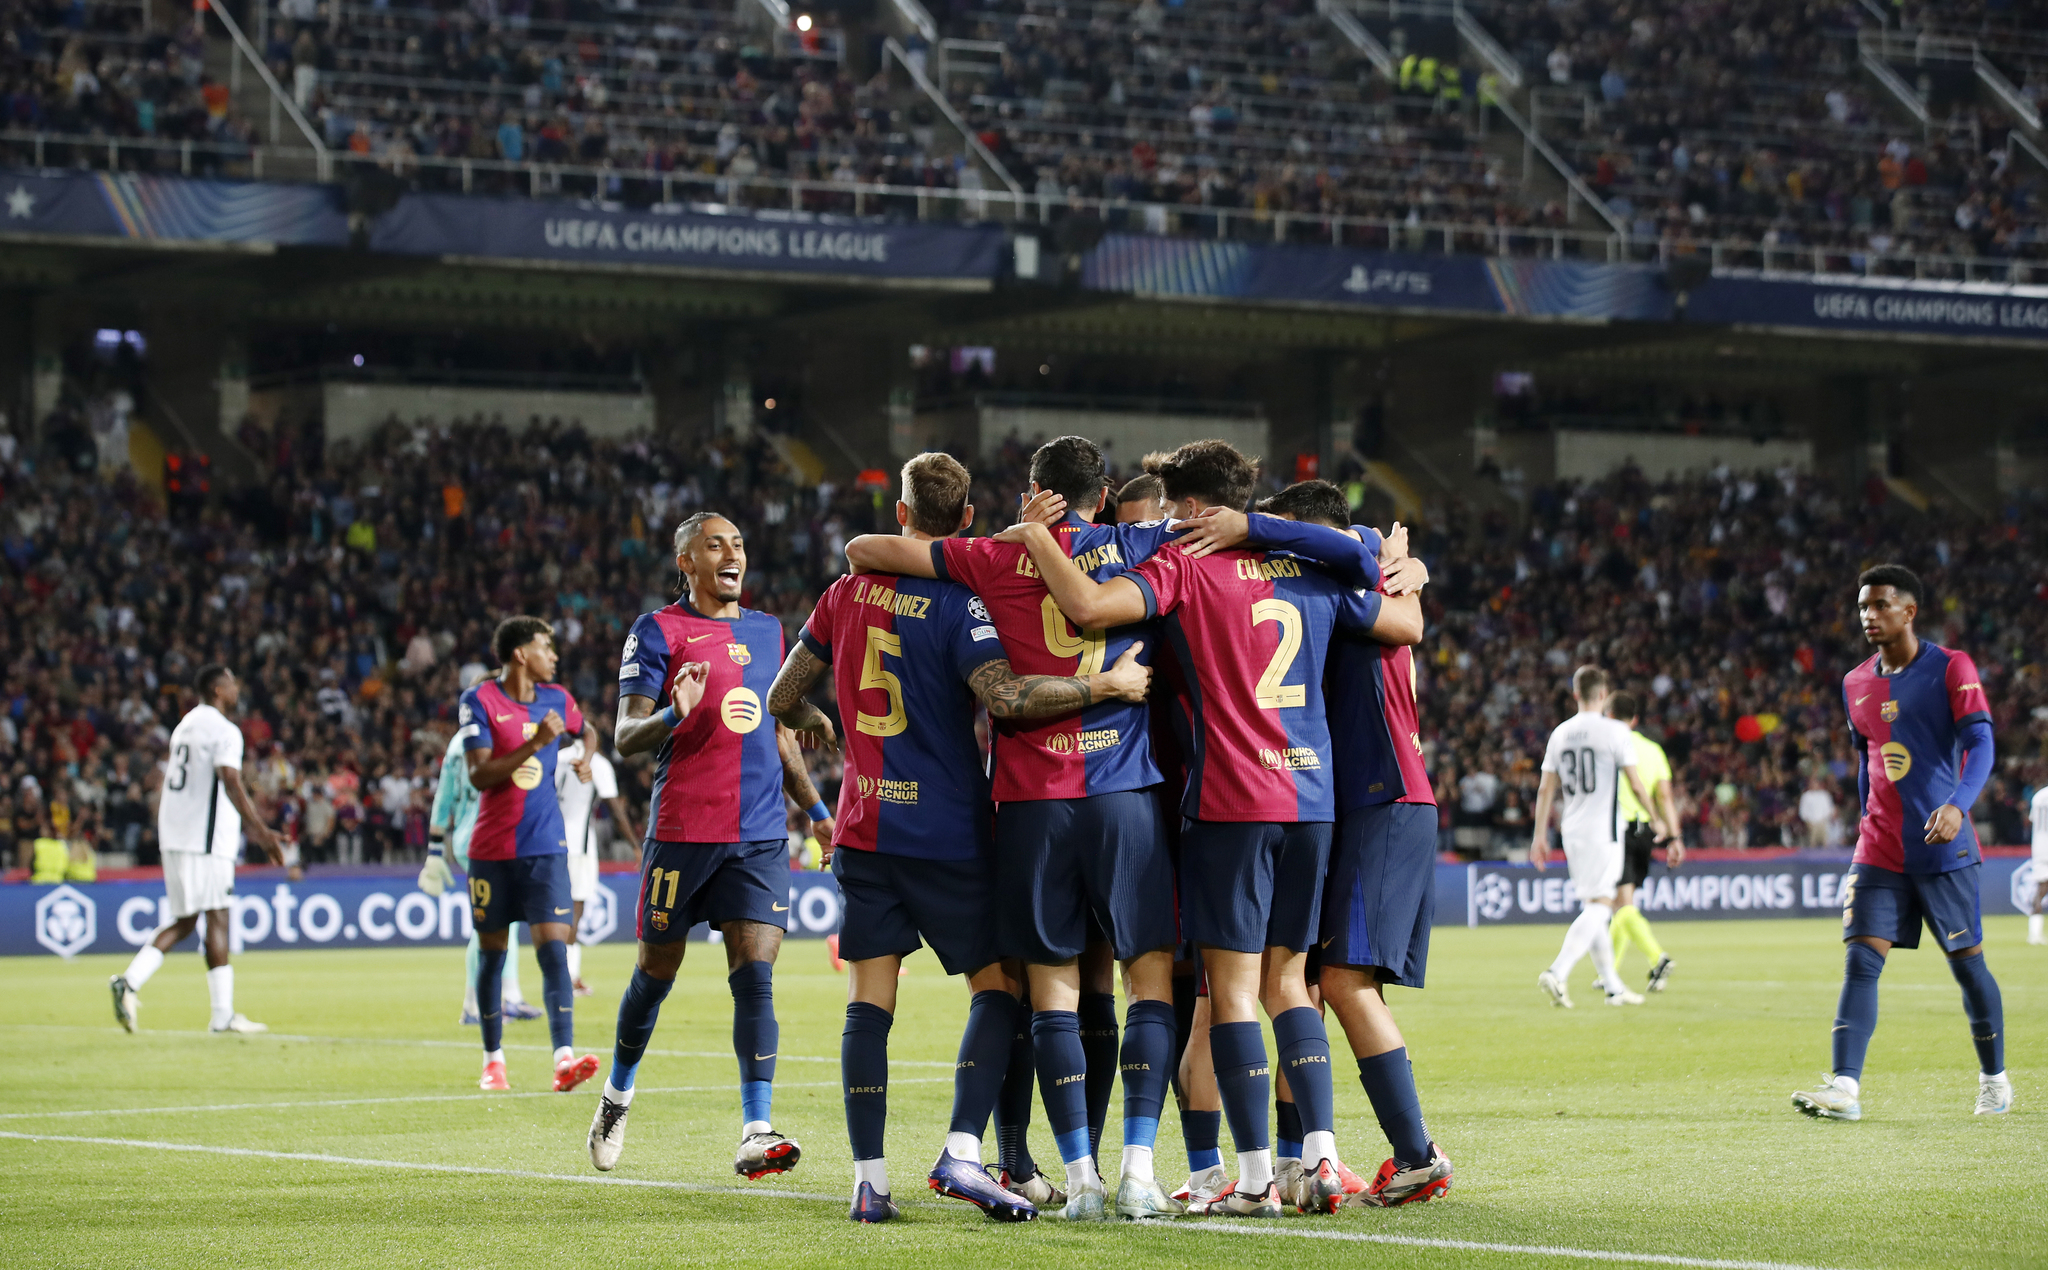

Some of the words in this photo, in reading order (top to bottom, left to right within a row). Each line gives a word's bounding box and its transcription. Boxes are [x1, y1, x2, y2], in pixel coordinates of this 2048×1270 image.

[544, 218, 618, 249] UEFA
[622, 221, 781, 258] CHAMPIONS
[788, 230, 887, 262] LEAGUE
[1813, 293, 1867, 319] UEFA
[1872, 295, 1995, 326] CHAMPIONS
[2000, 302, 2048, 329] LEAG
[1040, 593, 1106, 677] 9
[1251, 598, 1306, 709] 2
[855, 626, 908, 737] 5
[1076, 729, 1119, 742] UNHCR
[1284, 756, 1320, 768] ACNUR
[1561, 746, 1596, 795] 30
[876, 787, 918, 800] ACNUR
[877, 778, 918, 791] UNHCR
[469, 876, 492, 907] 19
[651, 867, 680, 909] 11
[1517, 878, 1583, 913] UEF
[1632, 873, 1796, 912] HAMPIONS
